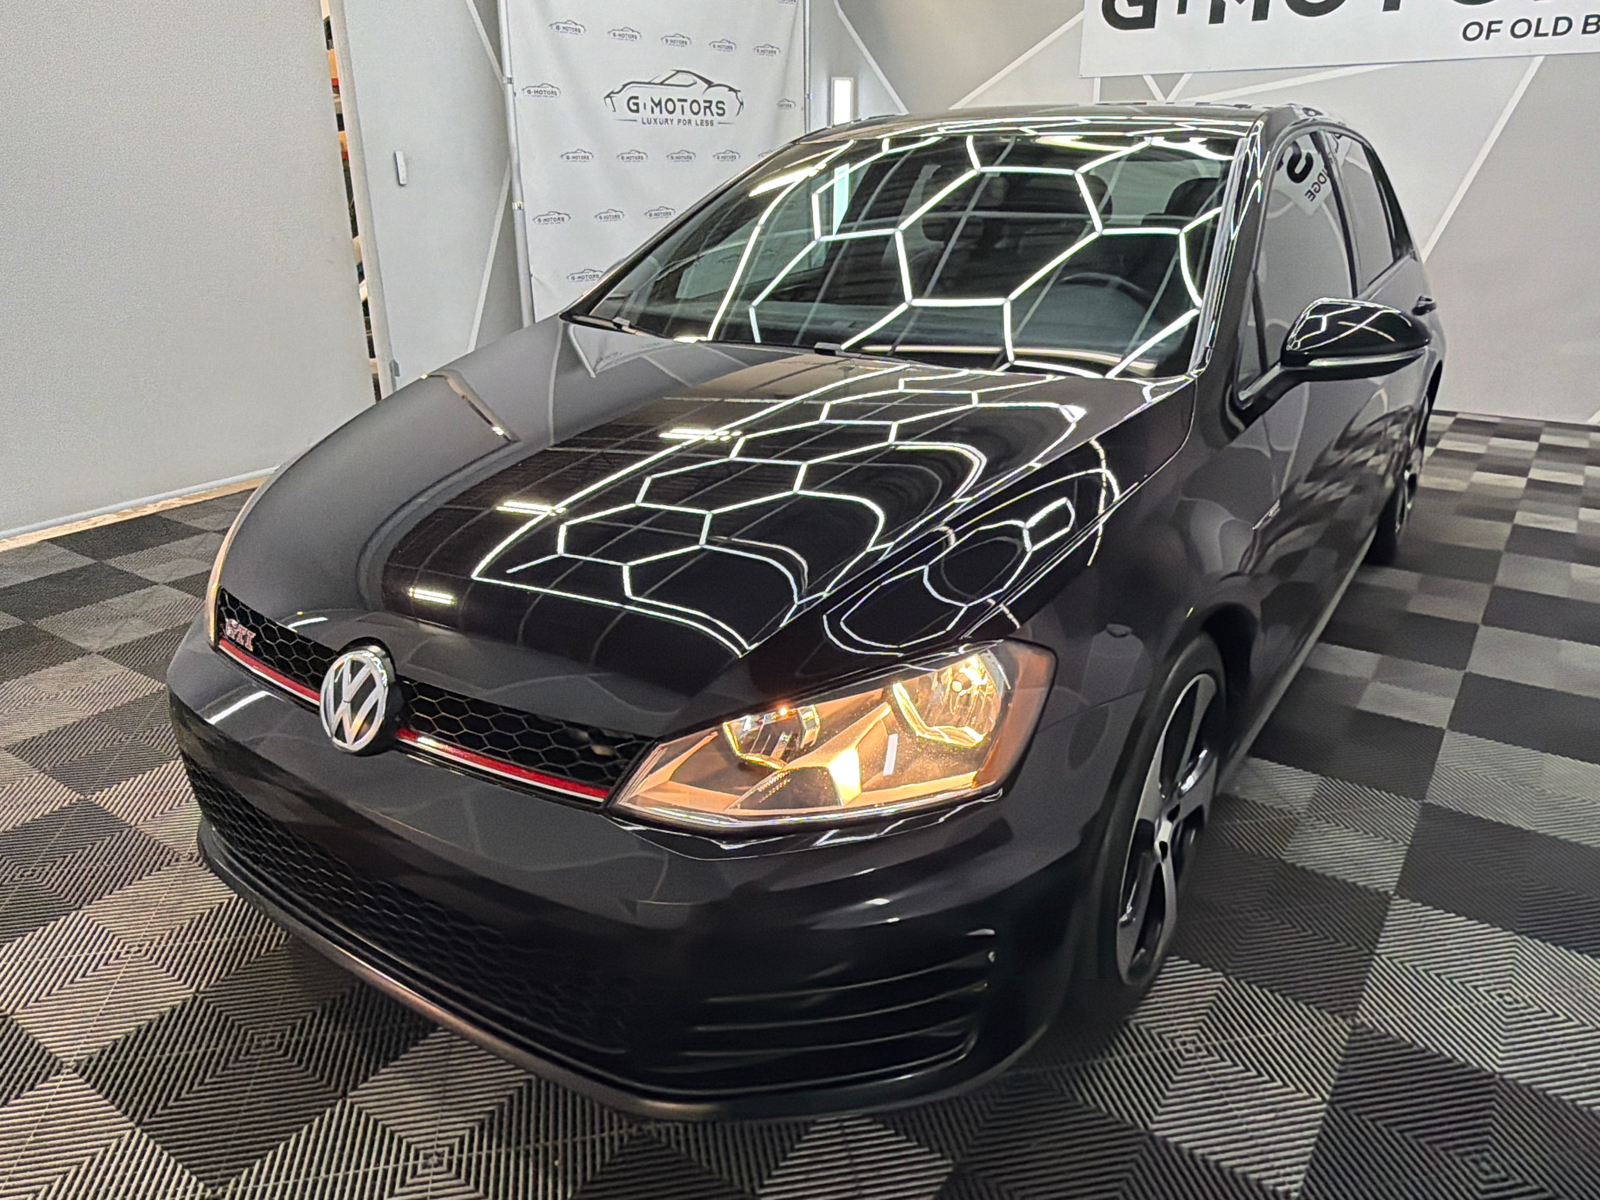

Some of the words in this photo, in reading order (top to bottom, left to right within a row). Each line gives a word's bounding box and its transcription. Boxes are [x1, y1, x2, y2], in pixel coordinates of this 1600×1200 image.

[1462, 20, 1504, 42] OF
[1510, 15, 1574, 39] OLD
[641, 118, 675, 126] LUXURY
[677, 118, 693, 127] FOR
[695, 119, 715, 127] LESS
[226, 618, 257, 651] GTI
